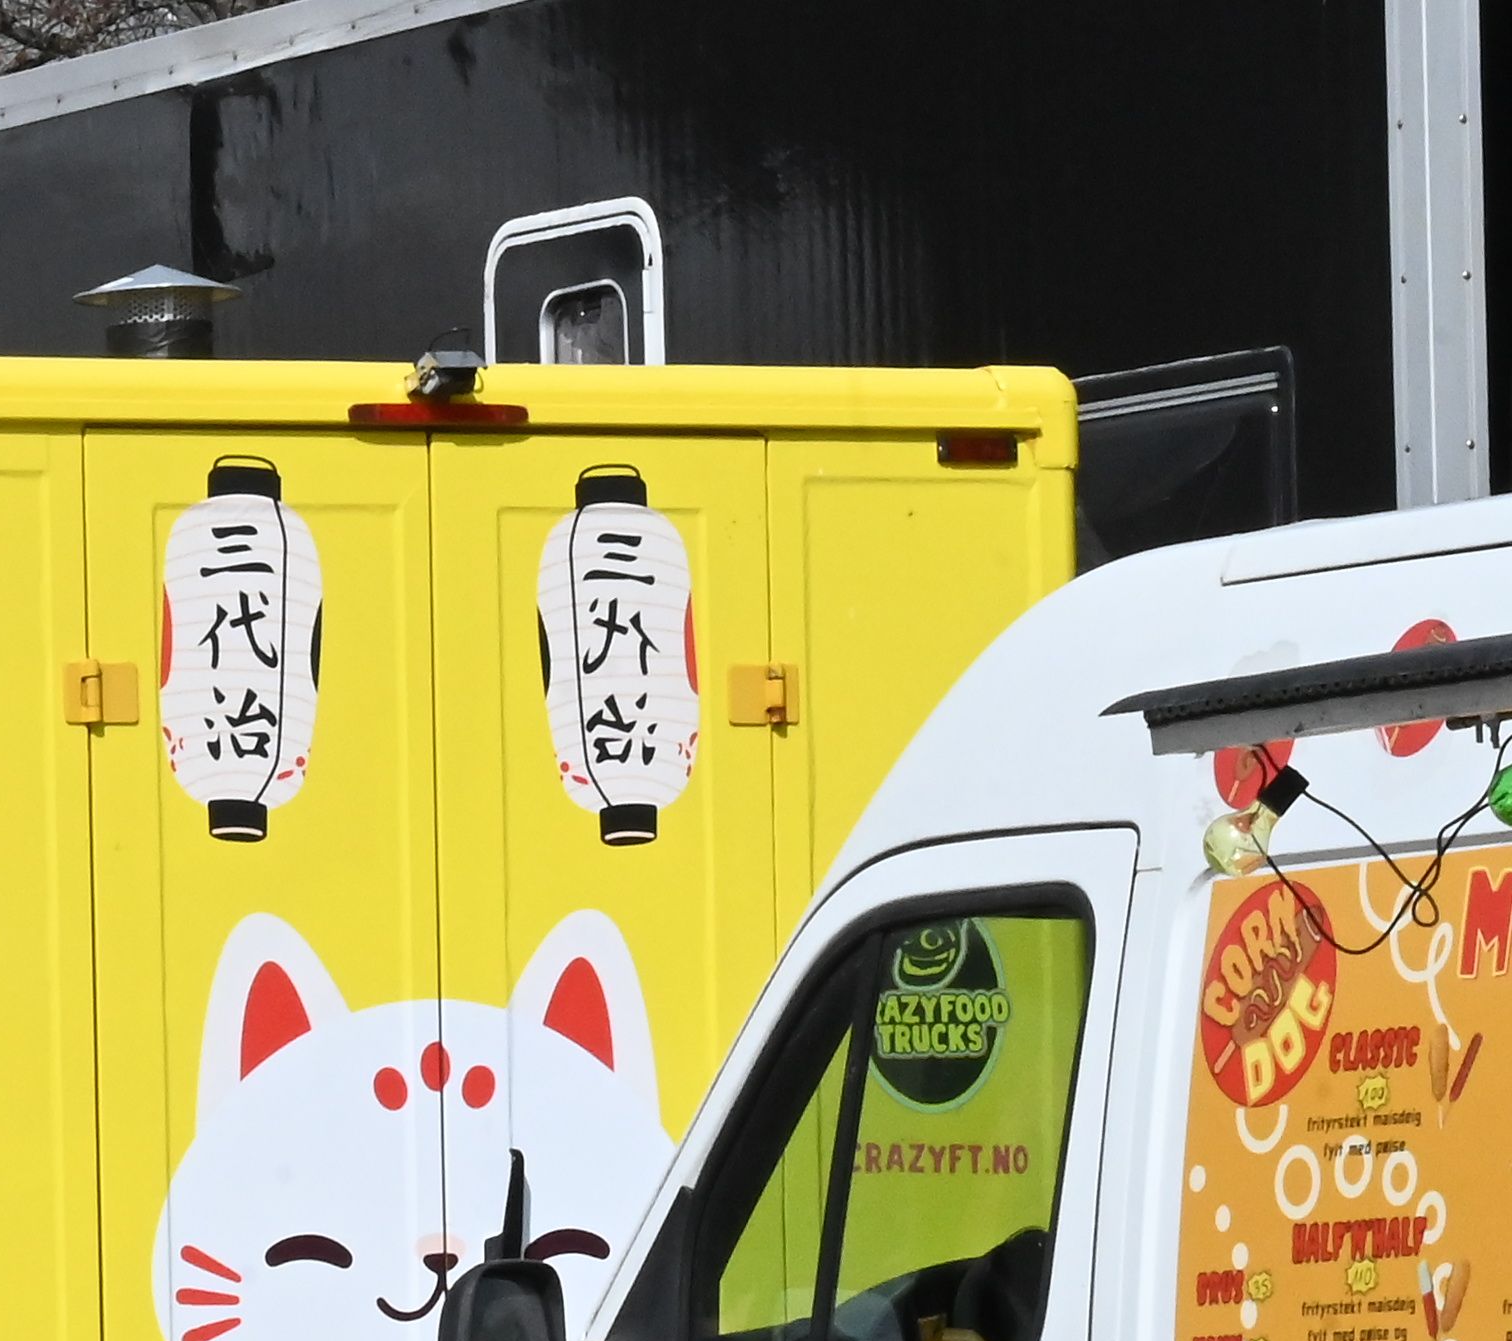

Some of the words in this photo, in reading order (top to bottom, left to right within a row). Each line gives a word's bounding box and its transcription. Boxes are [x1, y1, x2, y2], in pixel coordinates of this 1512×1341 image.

[1203, 884, 1302, 1027] CORN
[876, 994, 1009, 1024] AZYFOOD
[878, 1025, 983, 1053] TRUCKS
[1242, 972, 1333, 1104] DOG
[1329, 1026, 1421, 1073] CLASSIC
[1349, 1140, 1372, 1155] med
[1333, 1327, 1355, 1341] med
